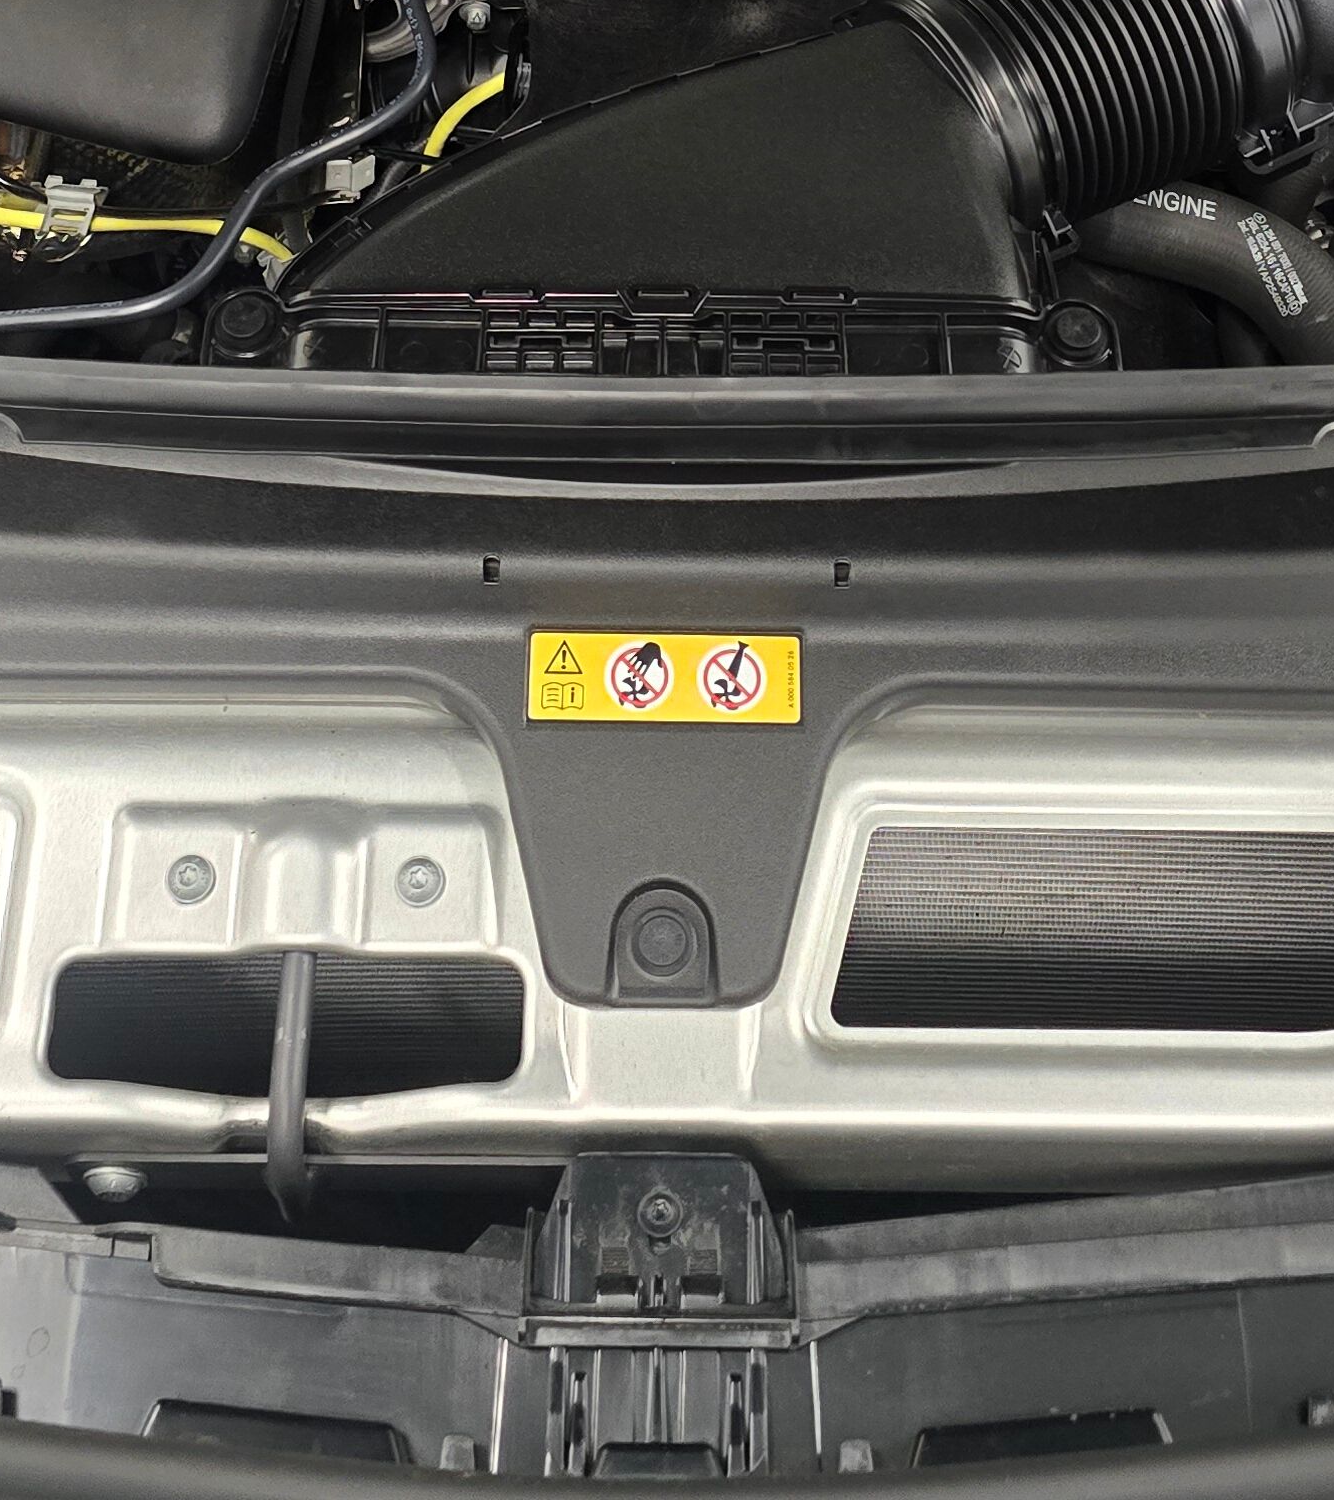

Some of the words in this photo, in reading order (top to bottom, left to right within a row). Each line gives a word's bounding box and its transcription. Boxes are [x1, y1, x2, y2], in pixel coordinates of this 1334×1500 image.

[787, 650, 795, 660] 26
[787, 661, 795, 671] 05
[787, 673, 795, 686] 584
[787, 687, 795, 702] 000
